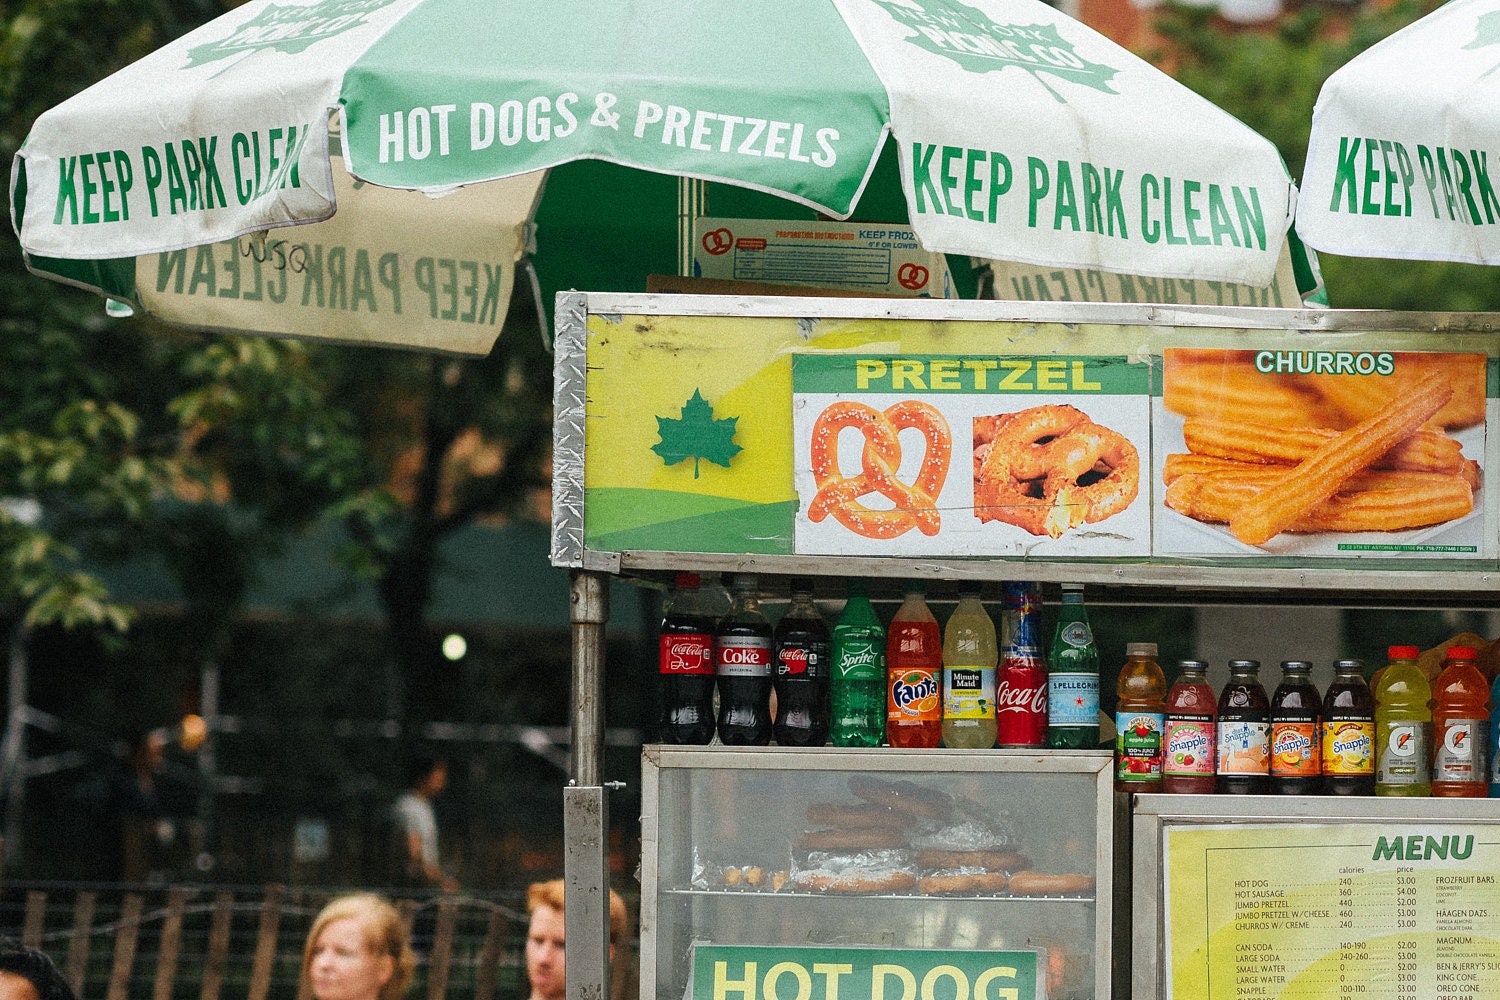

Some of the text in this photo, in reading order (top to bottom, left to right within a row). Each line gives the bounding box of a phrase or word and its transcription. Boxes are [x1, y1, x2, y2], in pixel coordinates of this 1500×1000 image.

[898, 6, 960, 28] NEW
[972, 22, 1053, 42] YORK
[1030, 43, 1085, 69] CO
[379, 92, 841, 169] HOT DOGS & PRETZELS
[53, 149, 134, 225] KEEP
[142, 135, 228, 217] PARK
[1329, 136, 1416, 218] KEEP
[911, 141, 1268, 252] KEEP PARK CLEAN
[859, 230, 887, 240] KEEP
[1255, 350, 1395, 376] CHURROS
[855, 359, 1102, 393] PRETZEL
[723, 649, 761, 665] Coke
[841, 652, 874, 667] Sprite
[953, 673, 980, 682] Minute
[956, 680, 976, 688] Maid
[893, 678, 938, 706] Fanta
[1169, 736, 1207, 754] Snapple
[1274, 736, 1310, 755] Snapple
[1333, 735, 1371, 754] Snapple
[1372, 834, 1474, 861] MENU
[1338, 866, 1414, 874] calories price
[1234, 877, 1416, 888] HOT DOG 240 $3.00
[1252, 890, 1285, 898] SAUSAGE
[1397, 888, 1417, 896] $4.00
[1235, 902, 1260, 910] JUMBO
[1261, 901, 1290, 909] PRETZEL
[1397, 899, 1417, 907] $2.00
[1235, 923, 1270, 931] CHURROS
[1285, 921, 1310, 930] CREME
[1436, 974, 1454, 982] KING
[1456, 974, 1477, 982] CONE
